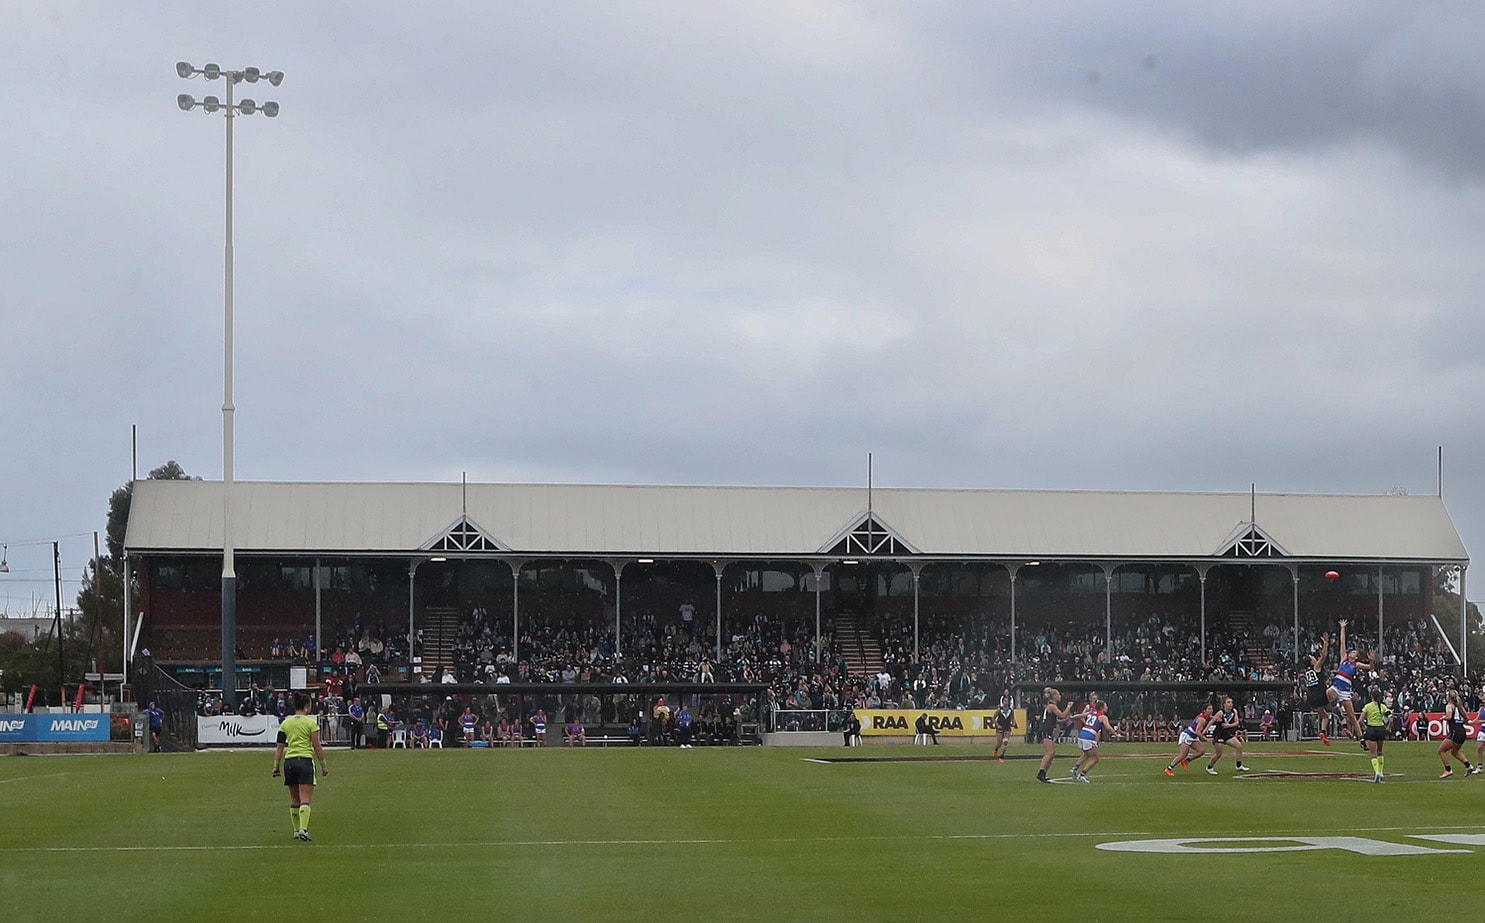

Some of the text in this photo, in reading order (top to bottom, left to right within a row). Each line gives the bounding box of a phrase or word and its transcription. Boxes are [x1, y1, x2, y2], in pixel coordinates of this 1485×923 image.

[873, 716, 908, 729] RAA
[929, 716, 963, 729] RAA
[1085, 713, 1097, 726] 23
